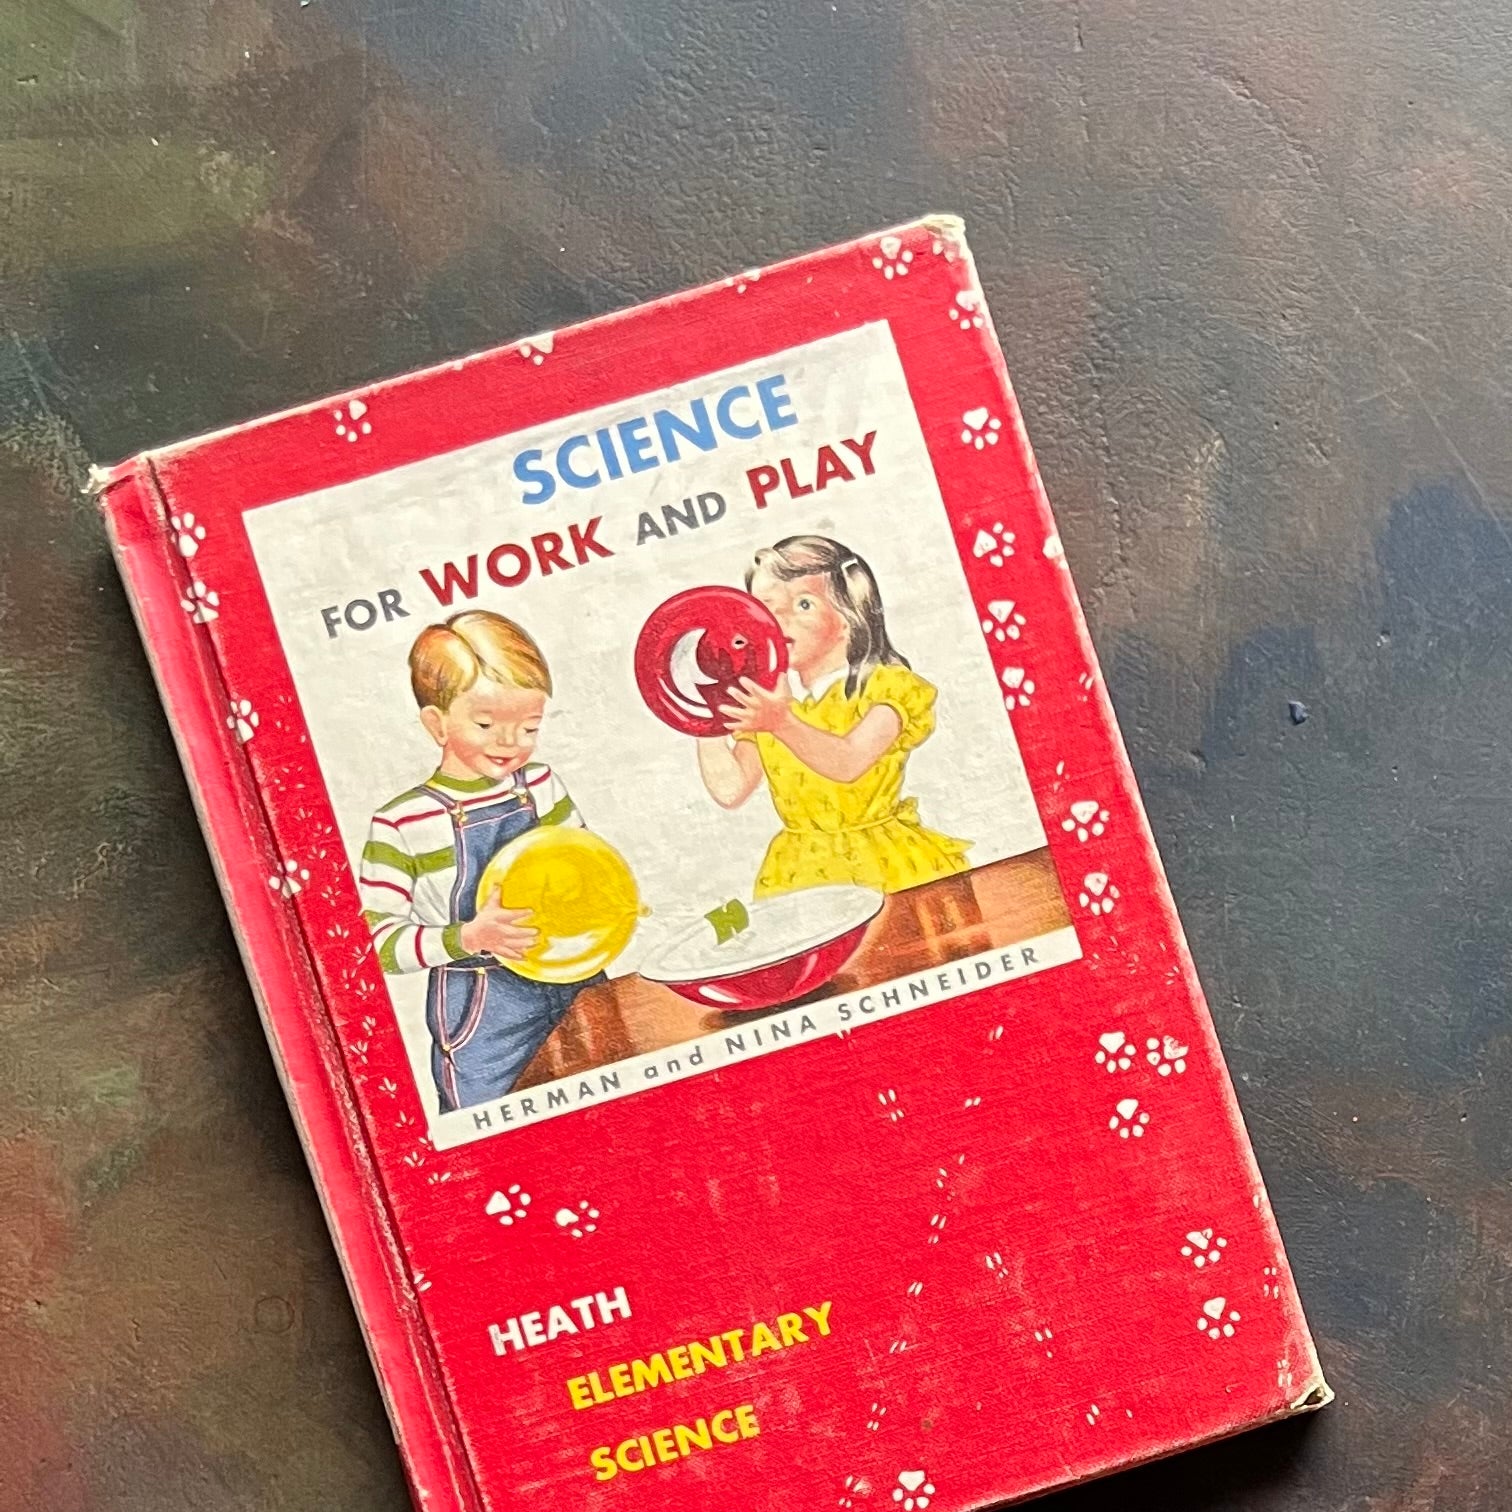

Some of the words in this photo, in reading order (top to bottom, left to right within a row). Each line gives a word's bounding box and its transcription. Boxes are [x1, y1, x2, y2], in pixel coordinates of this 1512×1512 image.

[513, 374, 798, 505] SCIENCE
[320, 588, 410, 640] FOR
[419, 516, 615, 606] WORK
[636, 491, 726, 546] AND
[746, 431, 878, 509] PLAY
[473, 1072, 622, 1131] HERMAN
[644, 1045, 705, 1080] and
[726, 1014, 818, 1055] NINA
[837, 946, 1040, 1022] SCHNEIDER
[488, 1286, 632, 1356] HEATH
[566, 1301, 832, 1410] ELEMENTARY
[590, 1405, 760, 1481] SCIENCE
